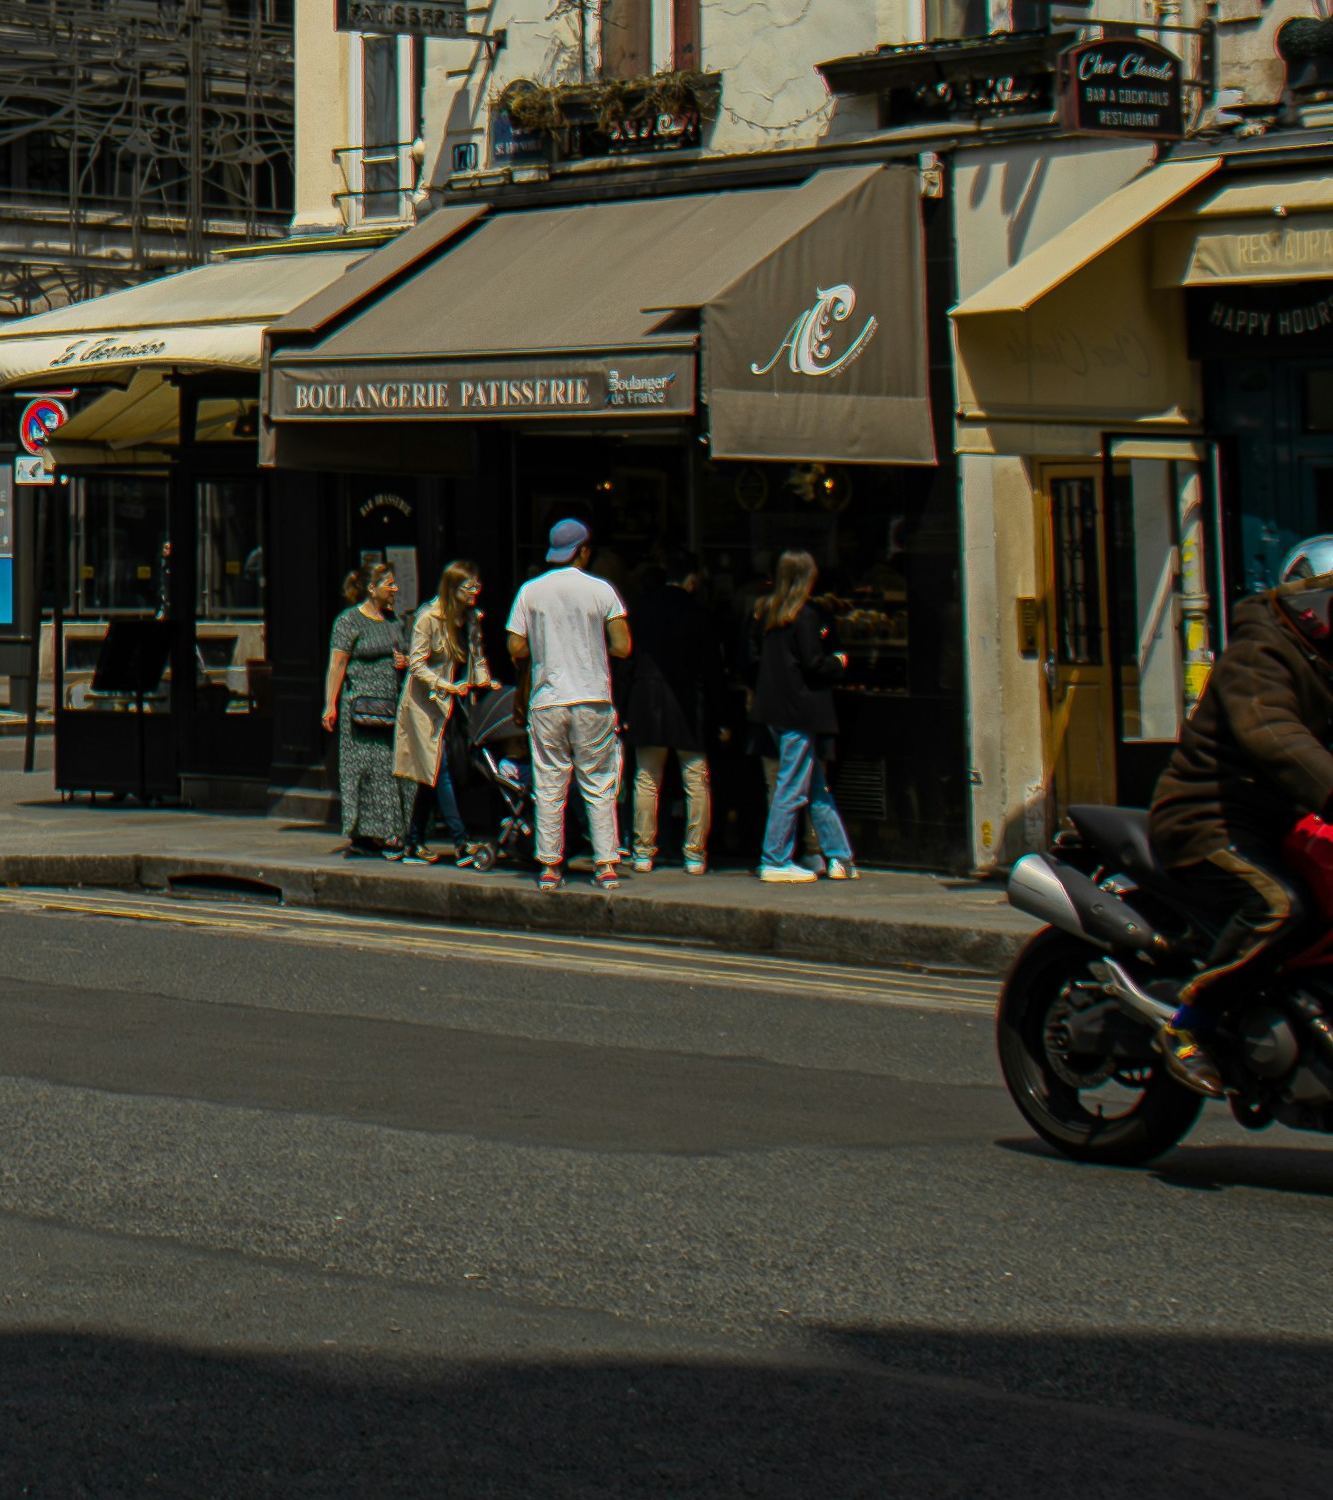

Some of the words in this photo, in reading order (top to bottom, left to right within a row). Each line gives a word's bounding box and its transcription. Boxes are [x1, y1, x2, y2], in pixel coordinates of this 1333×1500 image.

[1086, 87, 1106, 102] BAR
[1119, 88, 1170, 106] COCKTAILS
[1099, 109, 1160, 127] RESTAURANT
[1209, 301, 1271, 336] HAPPY
[294, 382, 450, 410] BOULANGERIE
[460, 377, 591, 408] PATISSERIE
[611, 390, 625, 405] de
[626, 390, 665, 405] France
